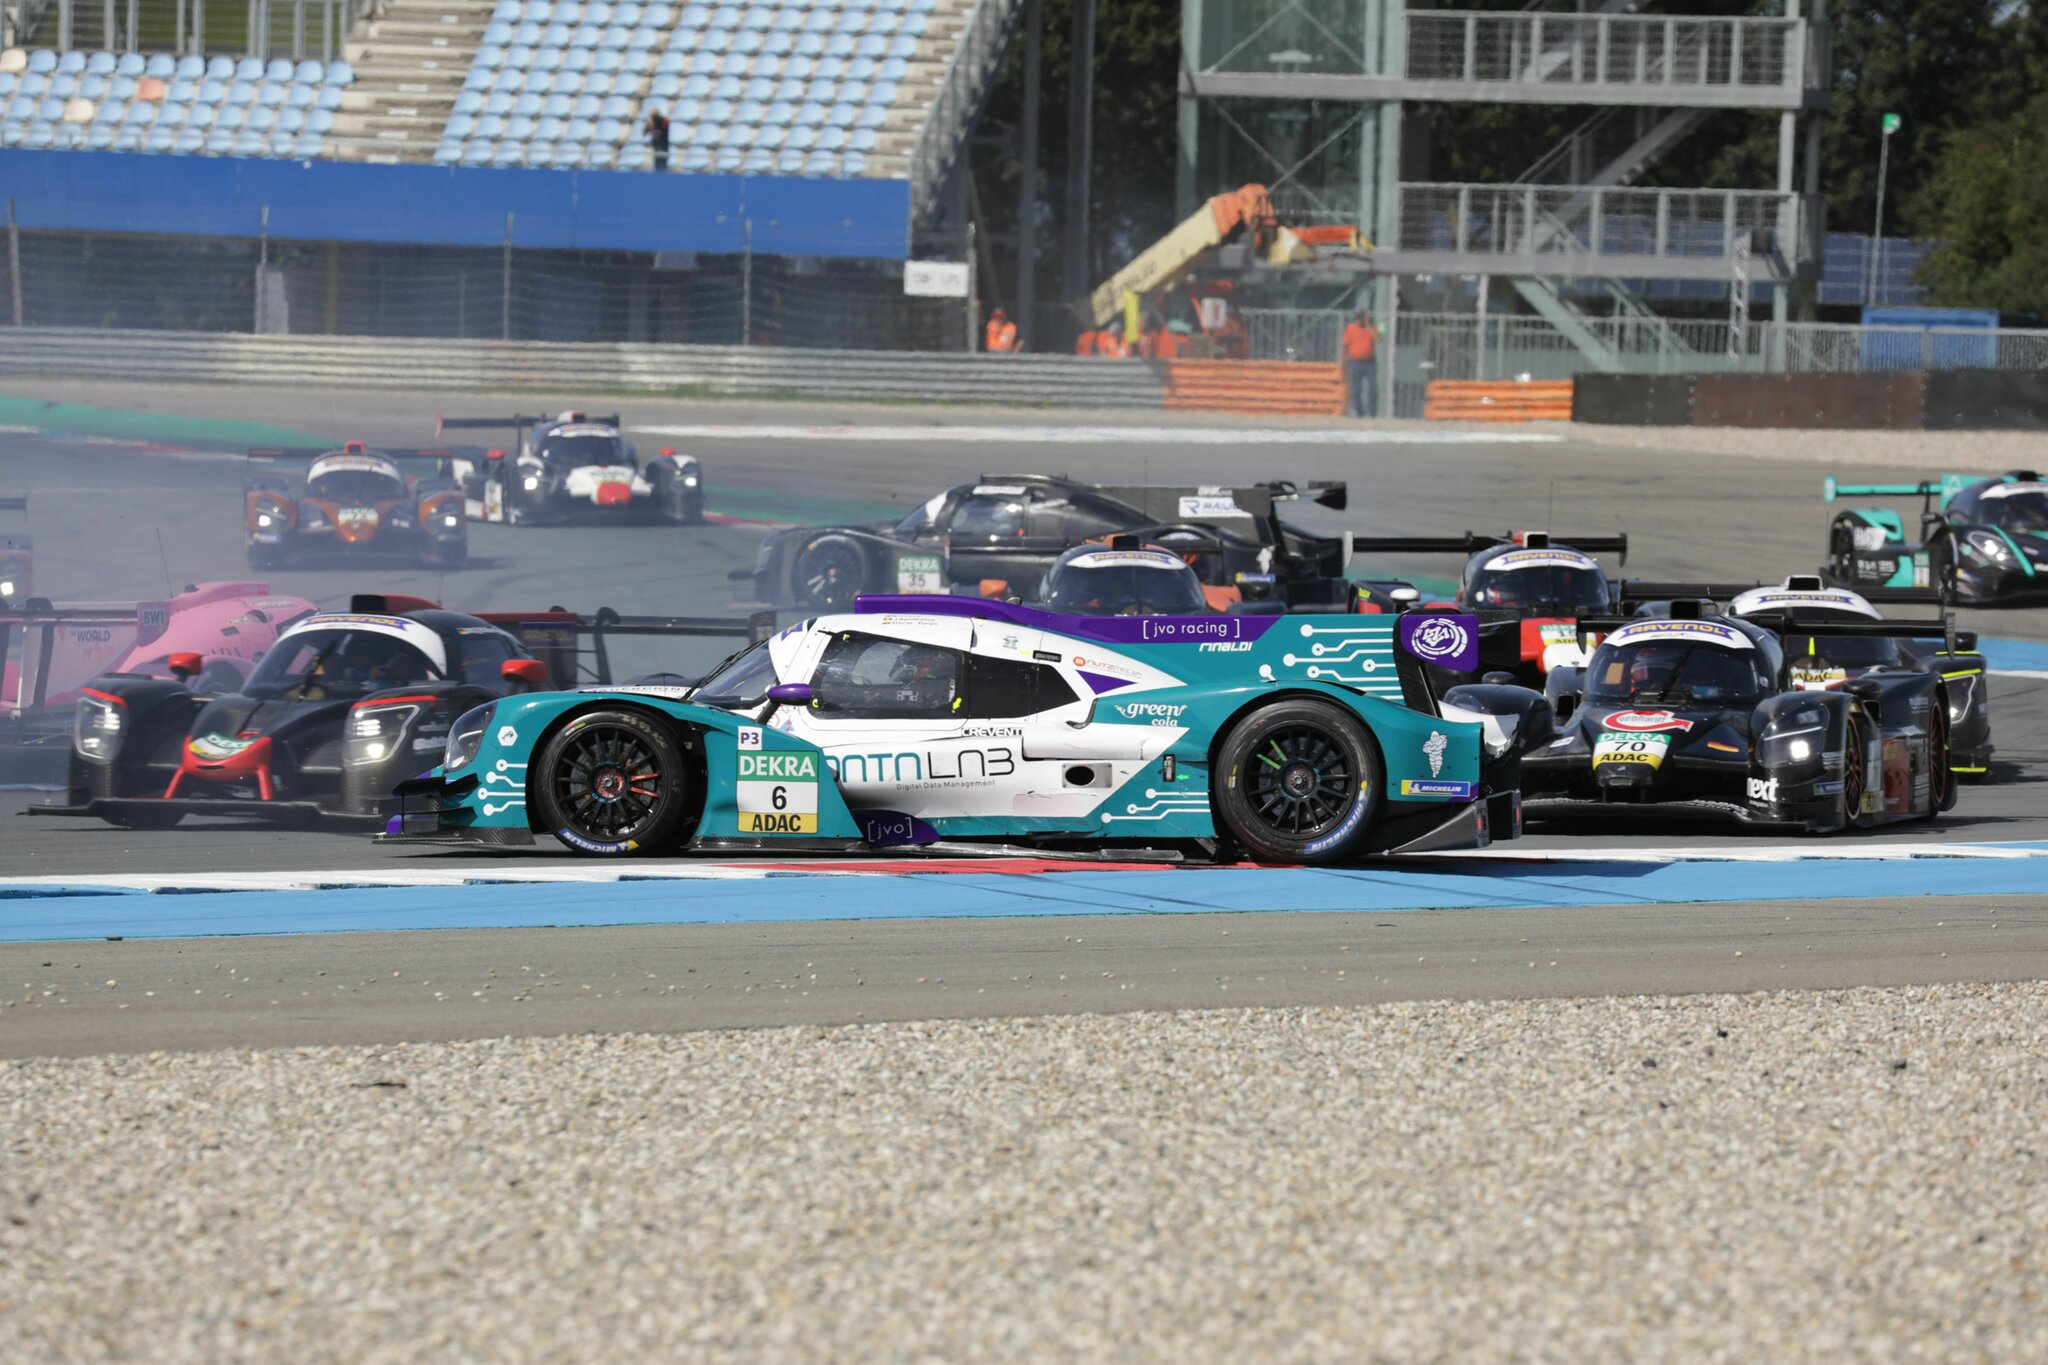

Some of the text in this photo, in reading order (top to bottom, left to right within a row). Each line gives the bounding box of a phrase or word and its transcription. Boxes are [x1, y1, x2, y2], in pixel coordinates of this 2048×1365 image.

[900, 558, 939, 572] DEKRA
[143, 609, 164, 625] BWT
[311, 616, 400, 628] RAVENOL
[1628, 622, 1727, 635] RAVENOL
[78, 630, 111, 642] WORLD
[1118, 703, 1188, 718] green
[1151, 716, 1179, 727] cola
[740, 732, 759, 745] P3
[1600, 732, 1666, 743] DEKRA
[1614, 741, 1646, 752] 70
[1601, 753, 1650, 762] ADAC
[739, 755, 816, 777] DEKRA
[896, 783, 922, 792] Digital
[943, 780, 996, 789] Management
[772, 785, 787, 810] 6
[752, 814, 802, 832] ADAC
[563, 831, 617, 852] MICHELIN
